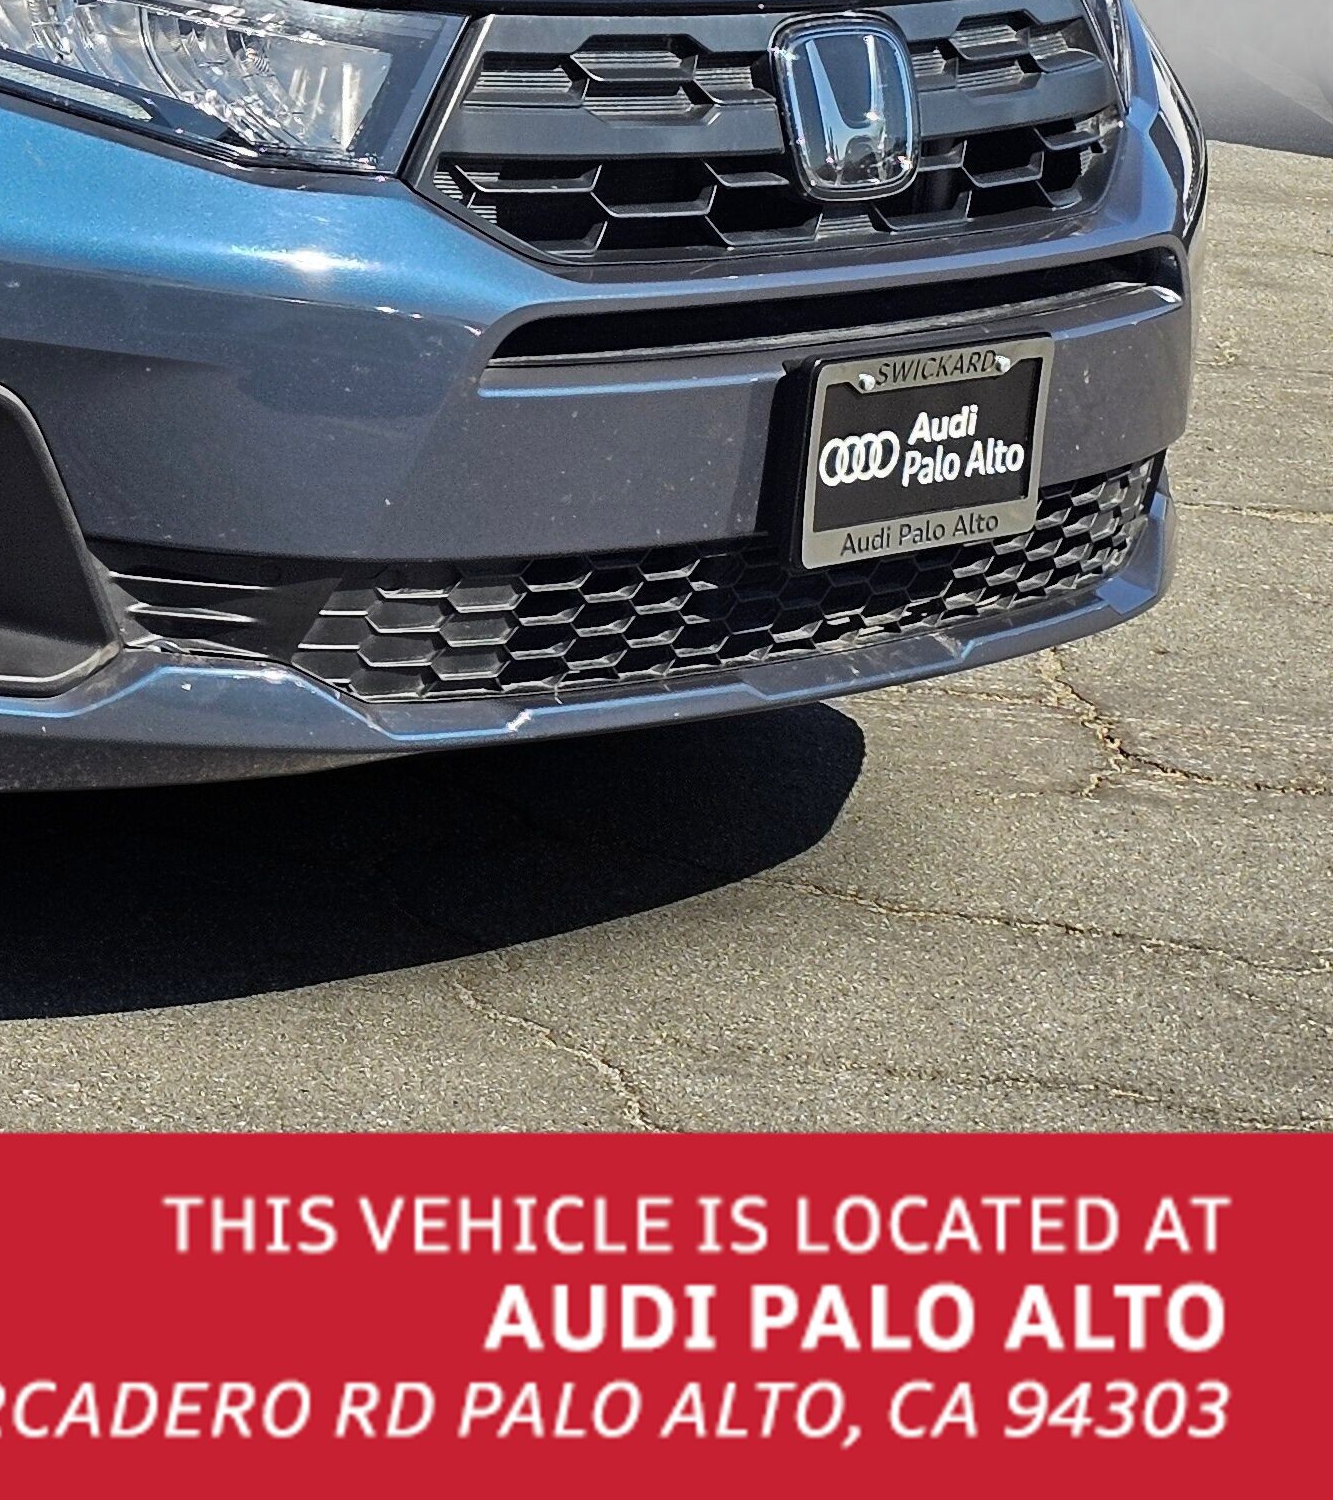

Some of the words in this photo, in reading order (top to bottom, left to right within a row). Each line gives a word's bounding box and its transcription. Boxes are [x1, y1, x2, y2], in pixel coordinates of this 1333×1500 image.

[876, 349, 997, 386] SWICKARD
[907, 404, 979, 445] Audi
[901, 442, 961, 487] Palo
[964, 437, 1025, 477] Alto
[840, 526, 891, 556] Audi
[898, 520, 946, 546] Palo
[952, 512, 999, 537] Alto
